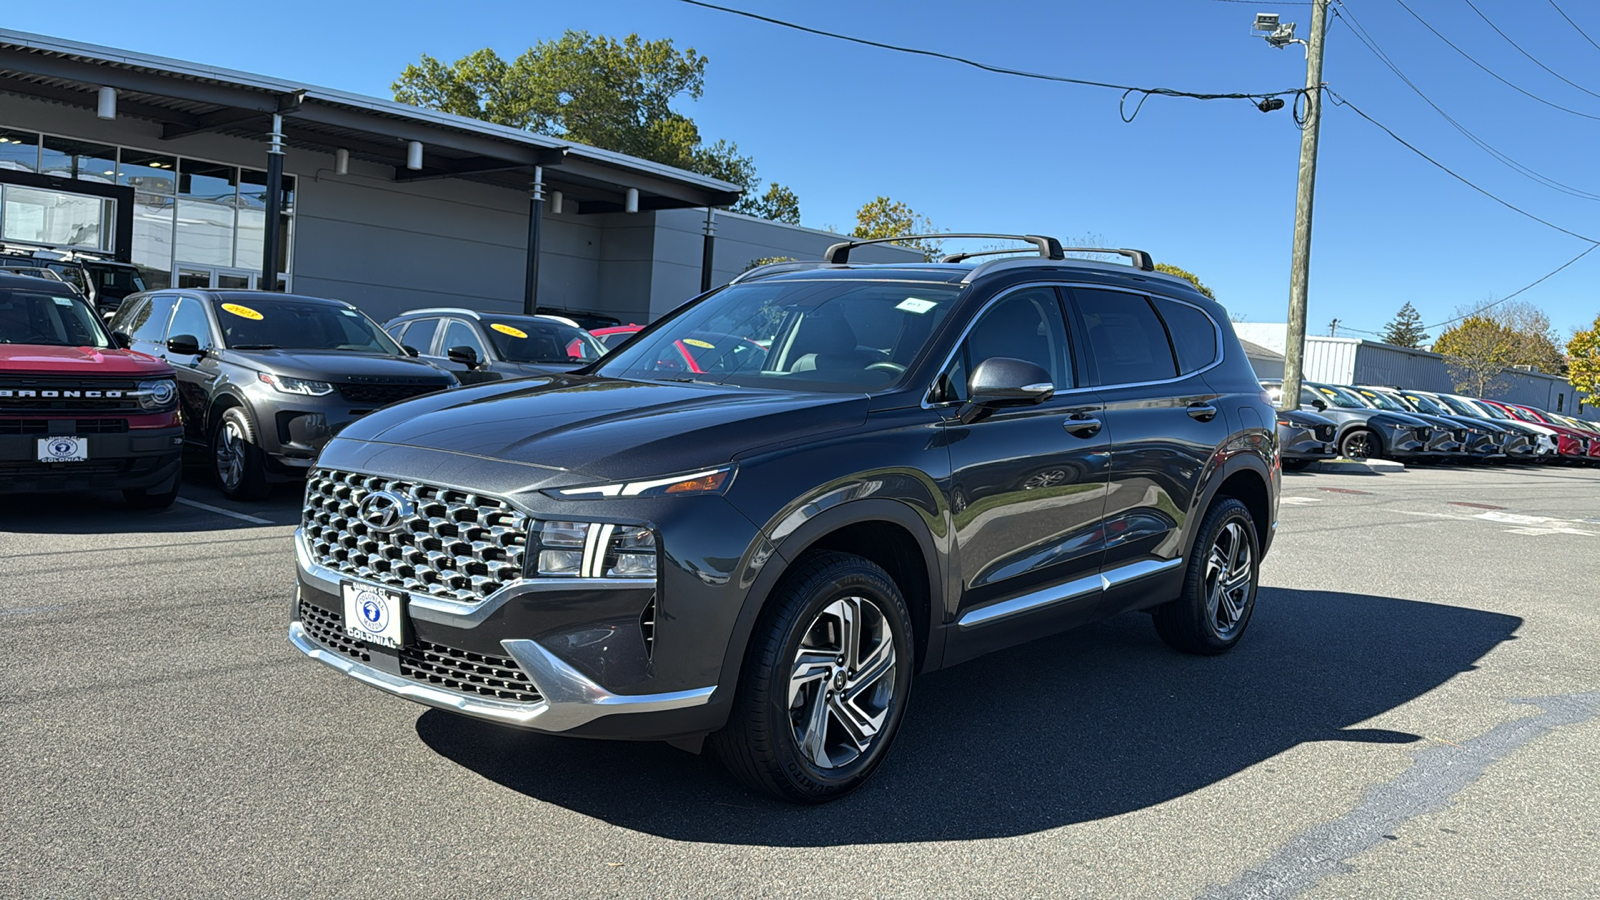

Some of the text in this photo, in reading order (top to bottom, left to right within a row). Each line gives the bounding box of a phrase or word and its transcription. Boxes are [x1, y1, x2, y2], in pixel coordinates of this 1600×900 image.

[0, 390, 122, 398] BRONCO
[358, 594, 385, 612] COLONIAL
[347, 628, 397, 649] COLONIAL
